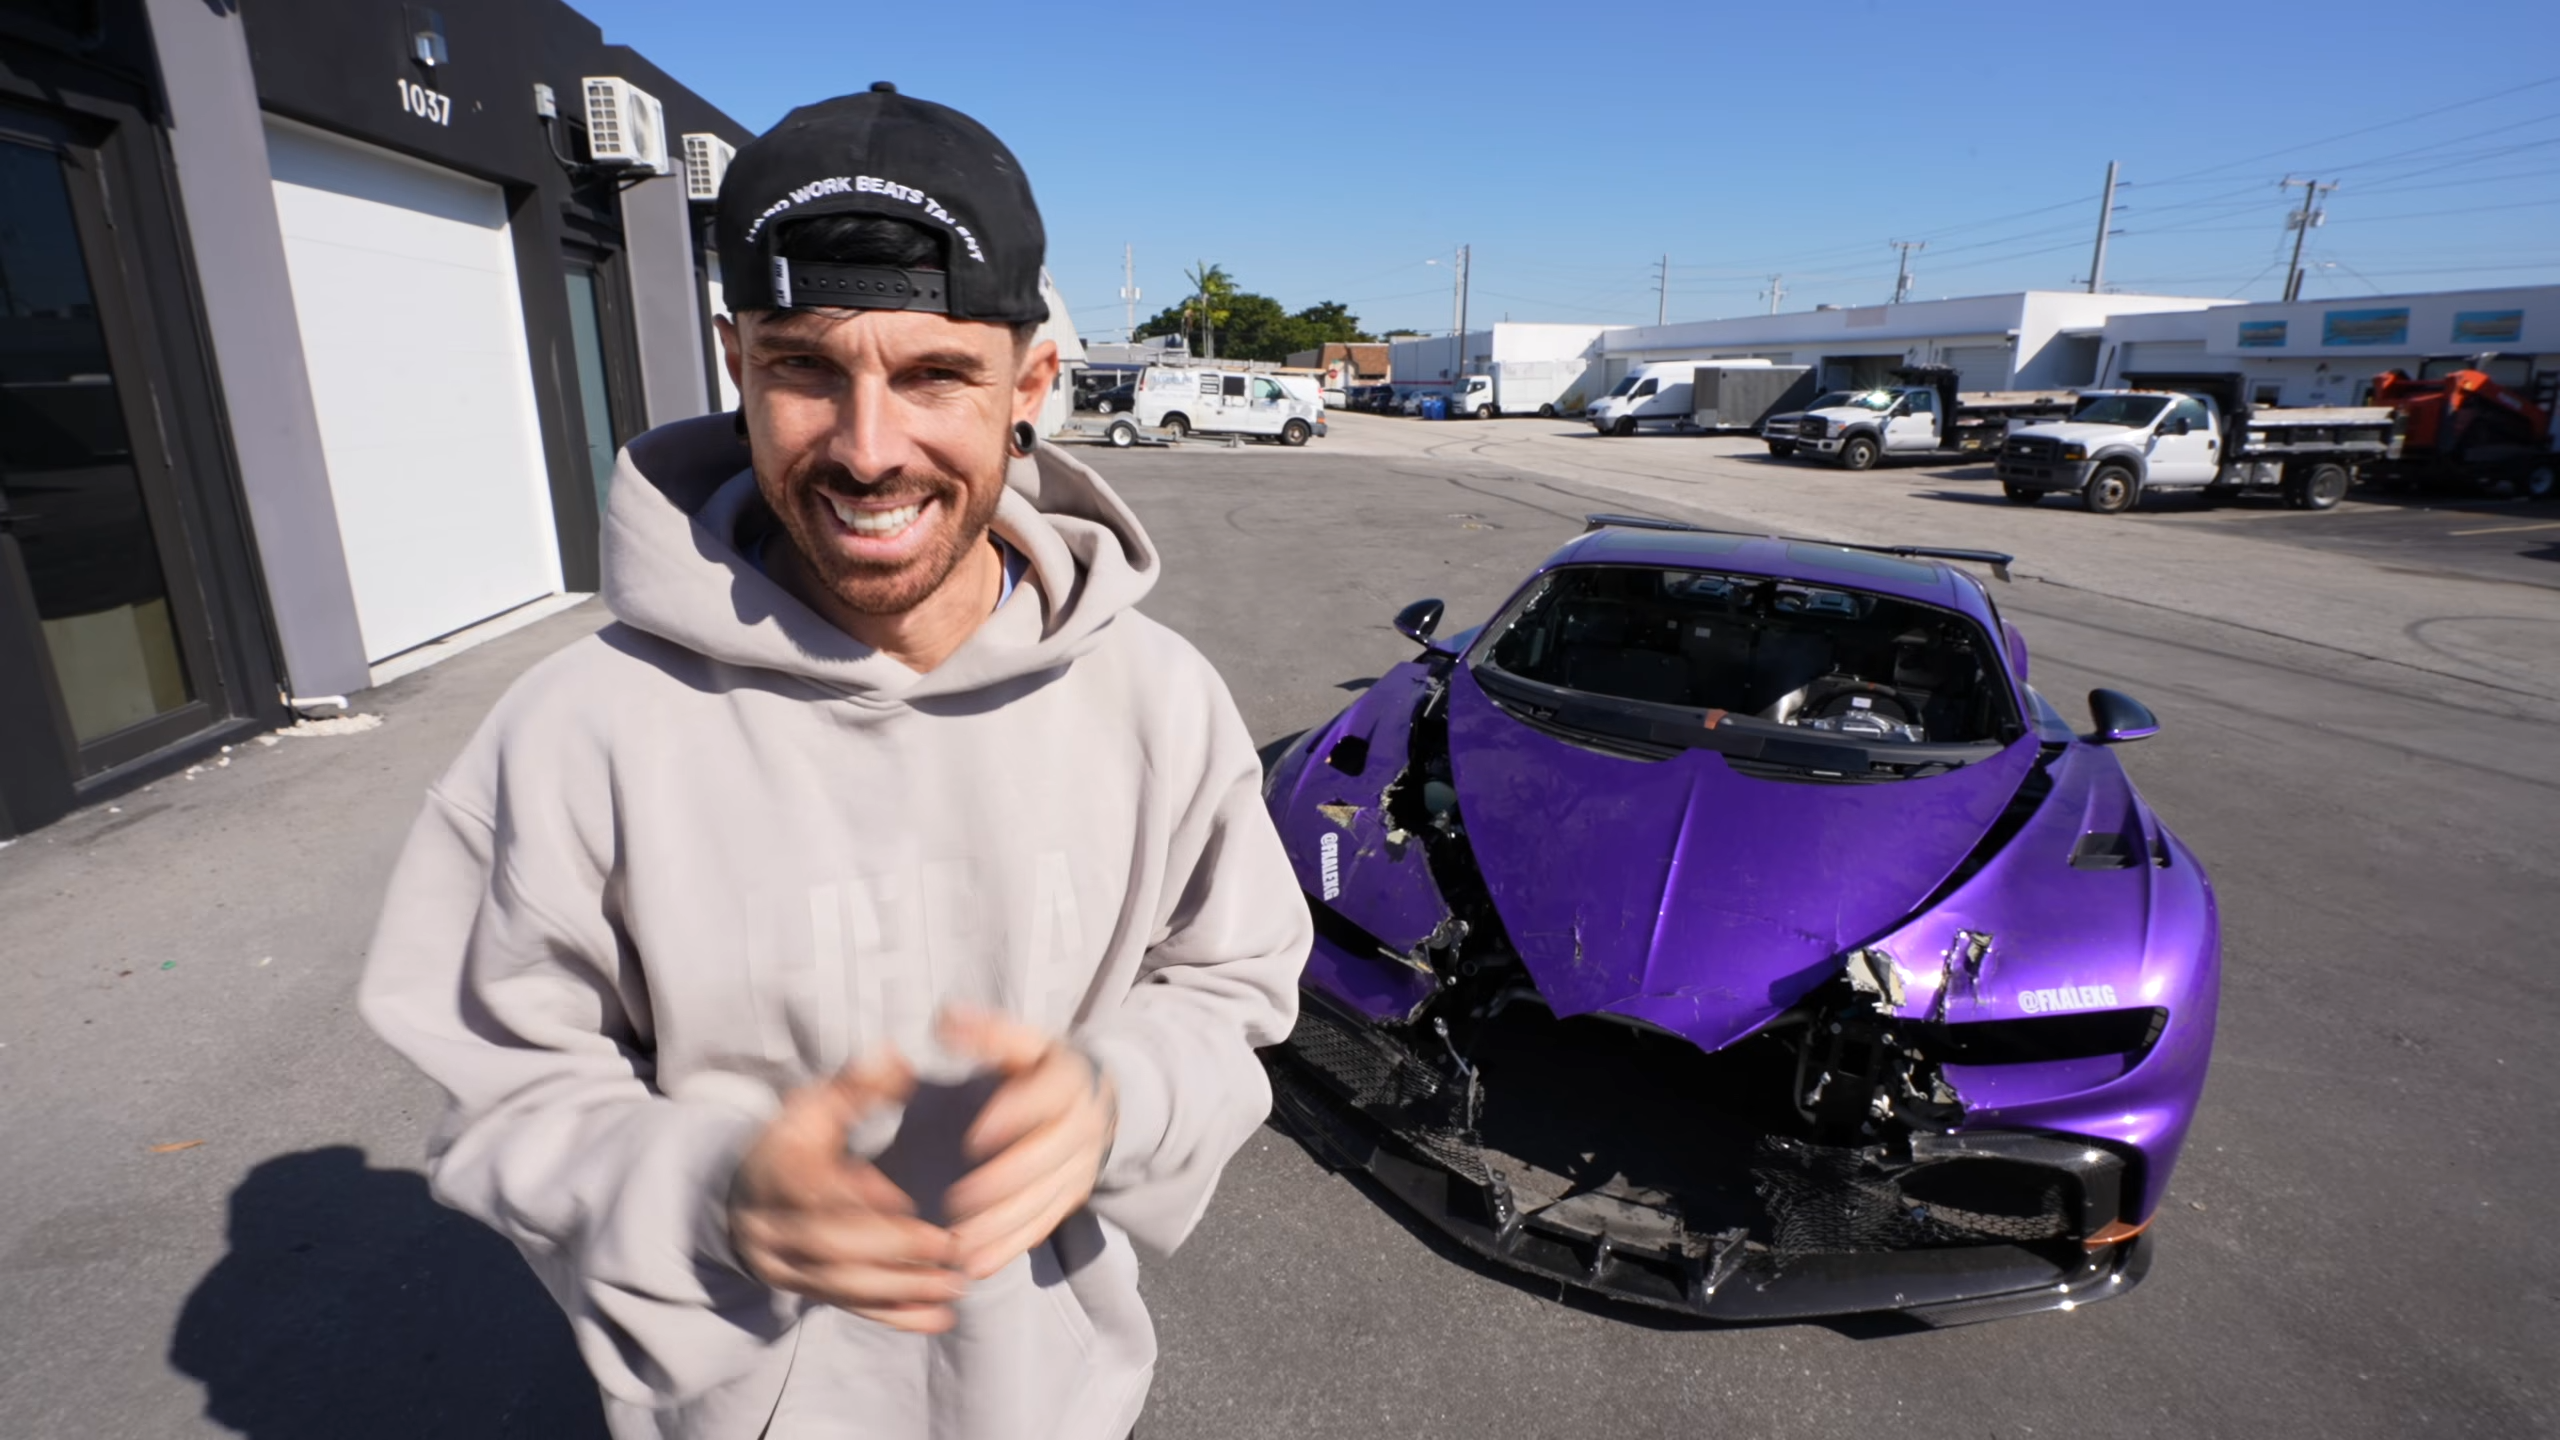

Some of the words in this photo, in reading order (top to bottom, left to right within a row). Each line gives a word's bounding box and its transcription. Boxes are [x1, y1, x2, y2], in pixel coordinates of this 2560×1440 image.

[397, 78, 450, 126] 1037
[788, 176, 853, 204] WORK
[855, 175, 925, 204] BEATS
[2018, 984, 2118, 1014] @FXALEXG
